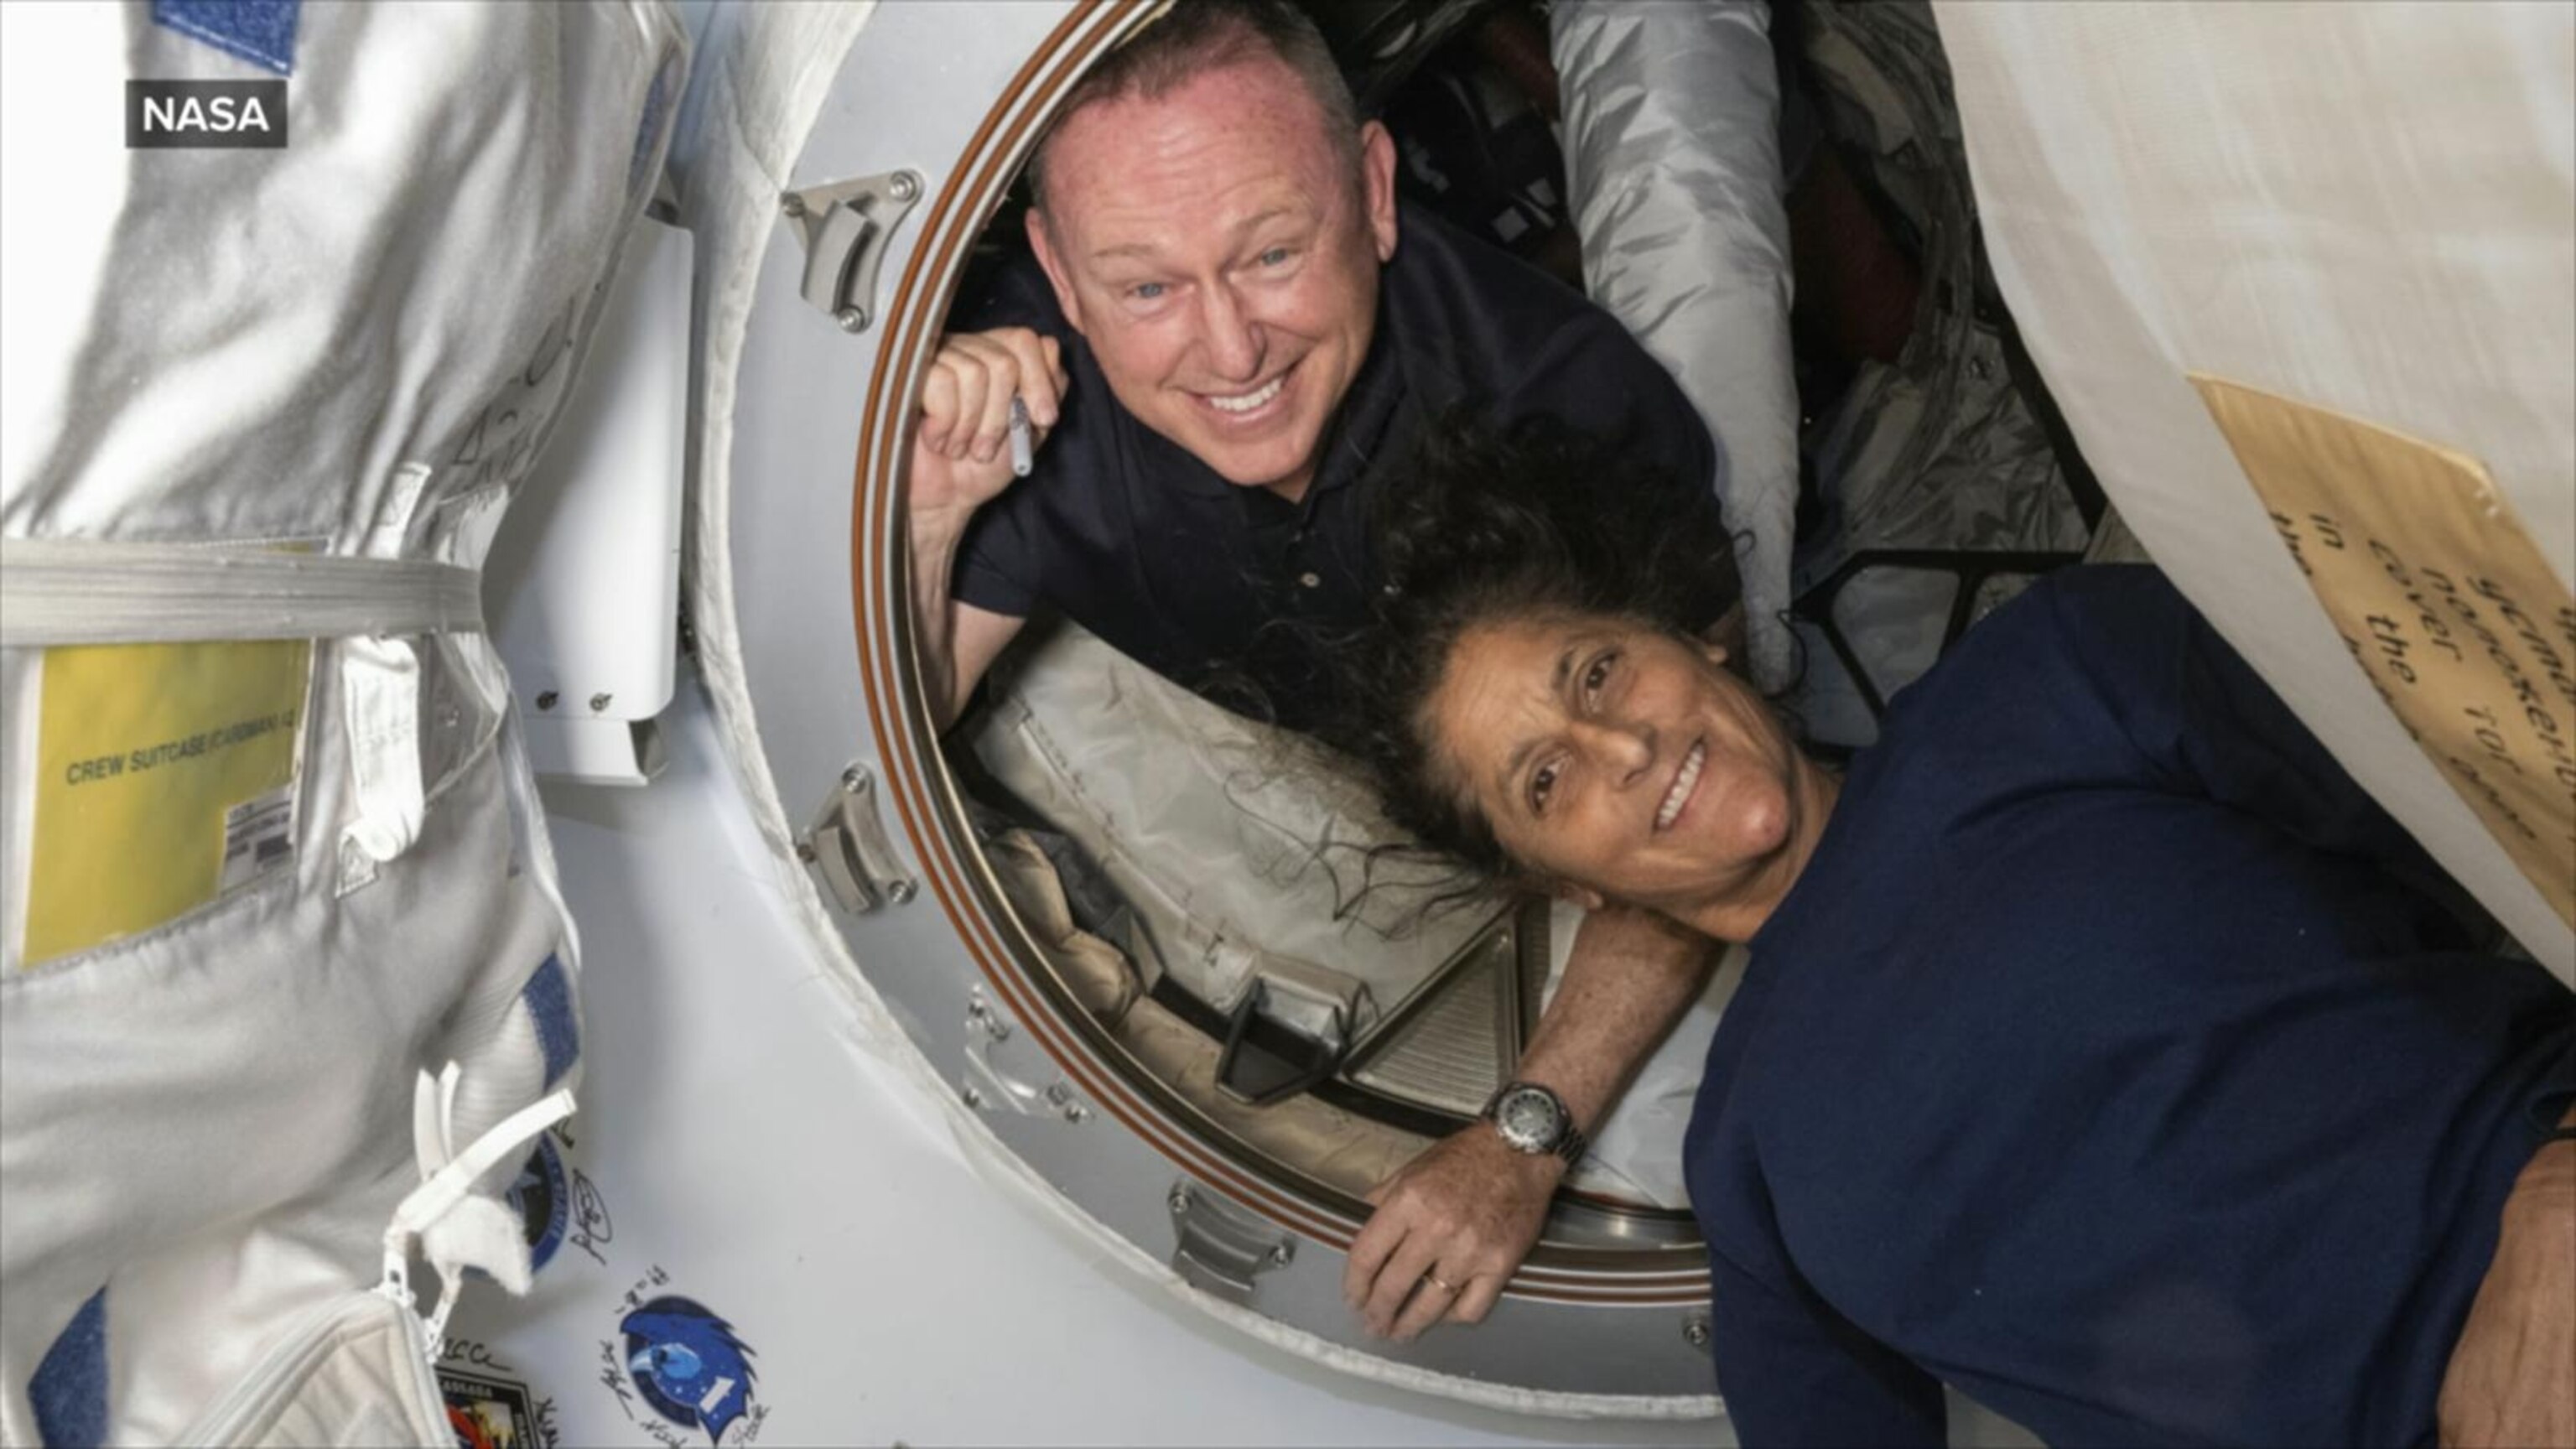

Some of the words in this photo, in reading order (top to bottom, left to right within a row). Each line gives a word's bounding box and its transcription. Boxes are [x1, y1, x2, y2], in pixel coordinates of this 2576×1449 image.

[2309, 514, 2345, 550] in
[2366, 615, 2418, 684] the
[2368, 538, 2463, 663] cover
[66, 755, 125, 785] CREW
[129, 733, 207, 773] SUITCASE
